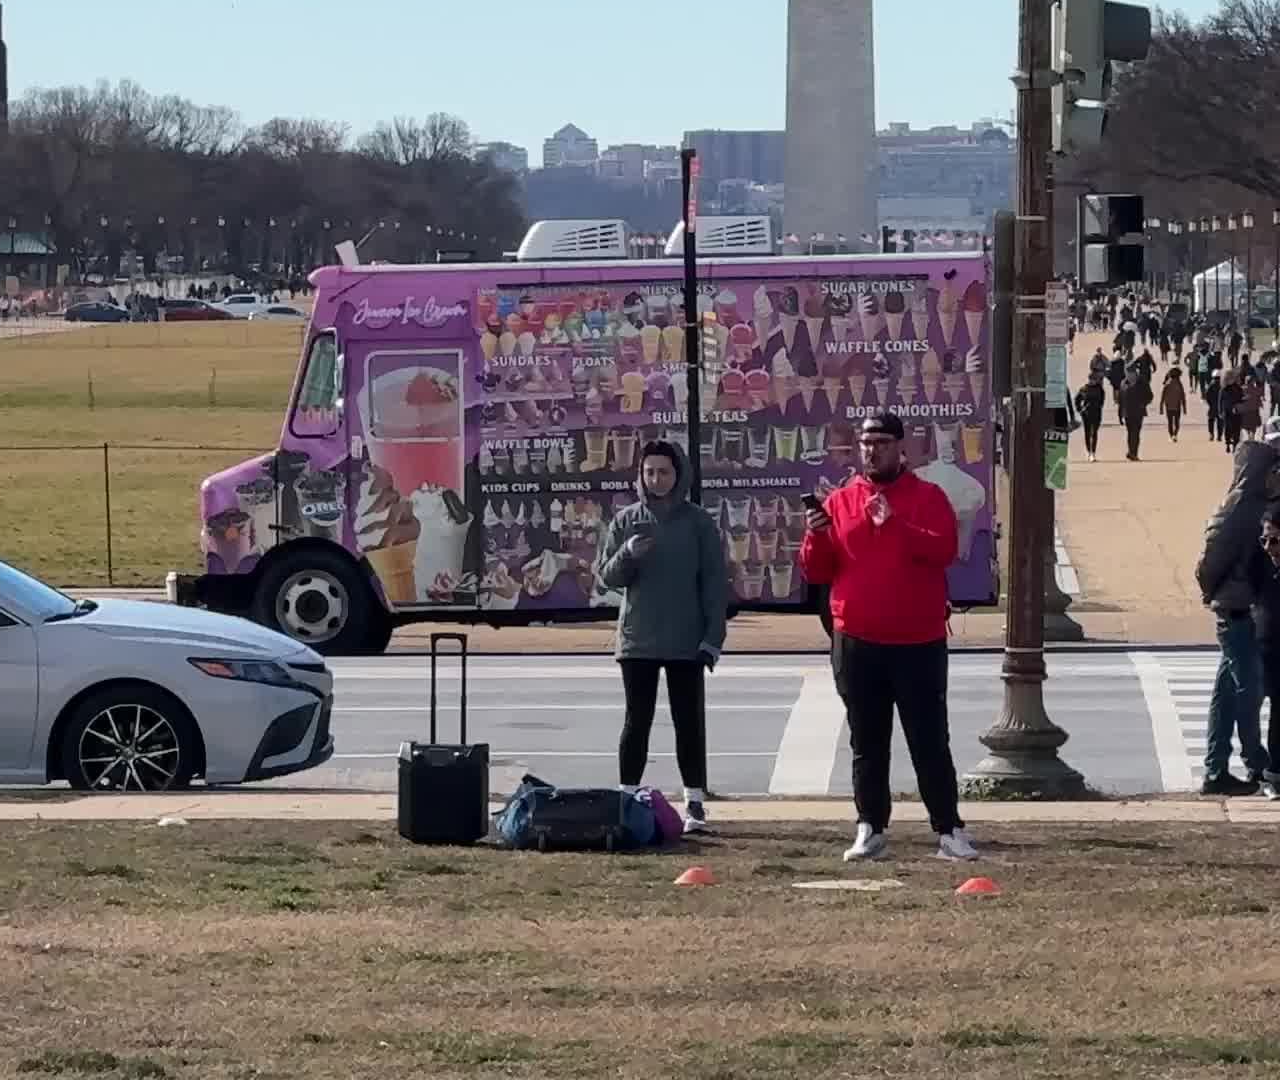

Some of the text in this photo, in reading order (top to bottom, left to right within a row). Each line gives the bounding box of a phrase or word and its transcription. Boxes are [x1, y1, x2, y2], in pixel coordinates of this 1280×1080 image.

[821, 280, 915, 294] SUGAR CONES
[423, 295, 468, 323] Cream
[825, 339, 929, 353] WAFFLE CONES
[491, 355, 551, 367] SUNDAES
[572, 356, 615, 368] FLOATS
[713, 409, 748, 423] TEAS
[888, 403, 973, 417] SMOOTHIES
[484, 437, 575, 450] WAFFLE BOWLS
[481, 482, 540, 494] KIDS CUPS
[551, 481, 591, 492] DRINKS
[601, 480, 629, 491] BOBA
[732, 477, 800, 488] MILKSHAKES
